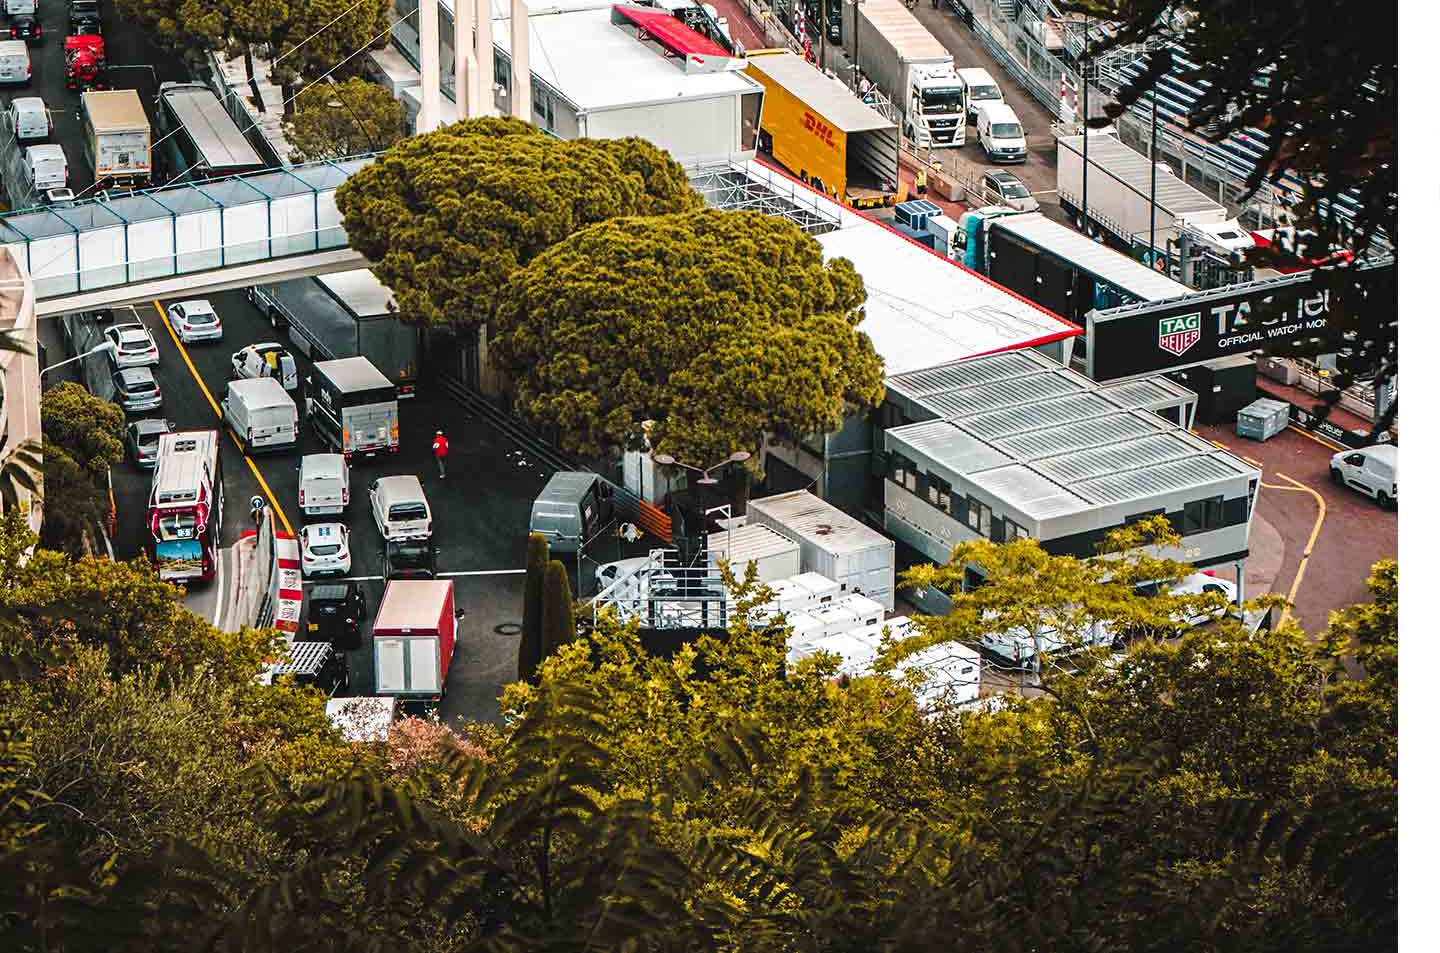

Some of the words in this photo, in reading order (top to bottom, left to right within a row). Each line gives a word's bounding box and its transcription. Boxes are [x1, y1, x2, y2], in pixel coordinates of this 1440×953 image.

[1162, 315, 1198, 333] TAG
[1218, 332, 1264, 348] OFFICIAL
[1267, 323, 1303, 338] WATCH
[1161, 330, 1199, 353] HEUER
